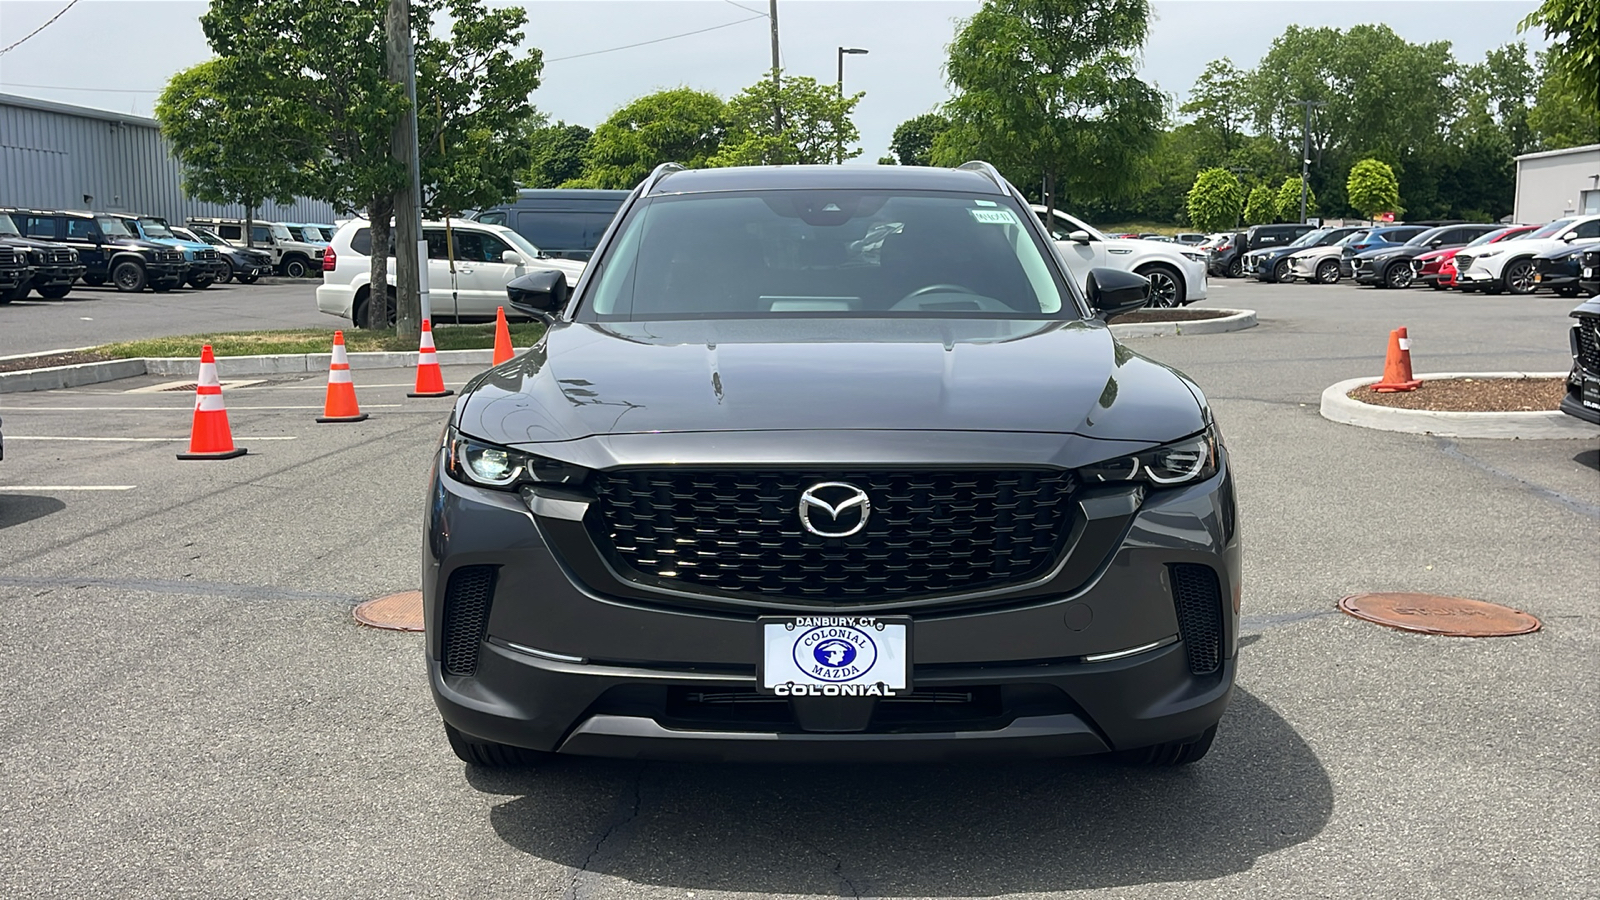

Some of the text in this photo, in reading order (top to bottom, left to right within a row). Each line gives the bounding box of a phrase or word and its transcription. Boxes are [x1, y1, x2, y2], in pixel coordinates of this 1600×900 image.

[796, 617, 876, 627] DANBURY, CT
[804, 629, 867, 649] COLONIAL
[812, 664, 860, 678] MAZDA
[775, 684, 896, 696] COLONIAL
